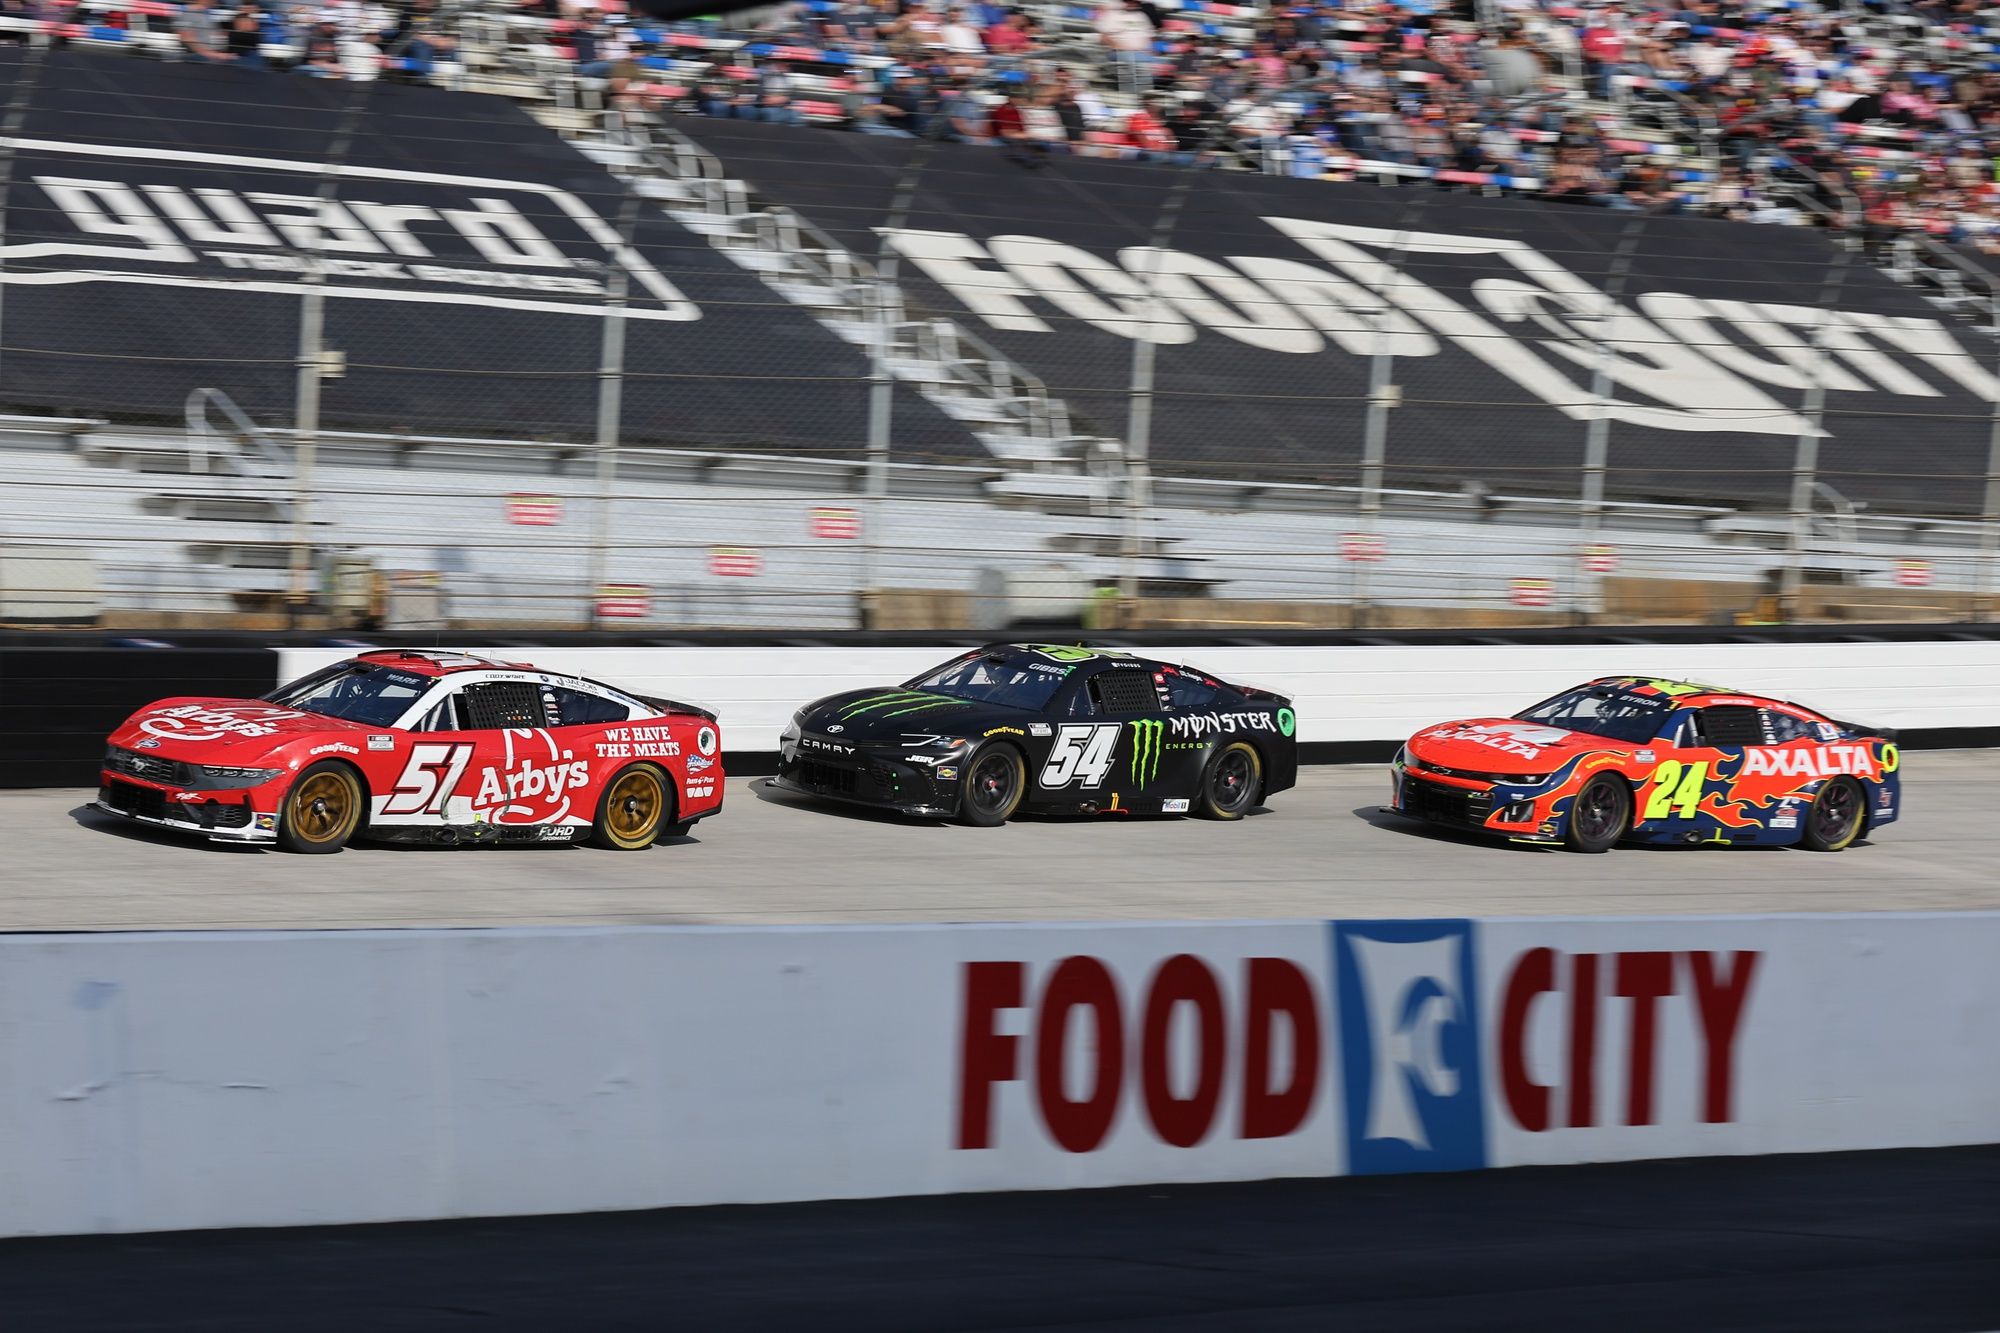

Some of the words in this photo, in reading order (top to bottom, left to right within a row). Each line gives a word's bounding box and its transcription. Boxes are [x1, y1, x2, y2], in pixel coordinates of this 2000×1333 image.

[31, 175, 574, 268] guard
[202, 250, 416, 280] TRUCK
[870, 226, 1442, 357] FOOD
[1636, 291, 2000, 402] CITY
[1028, 662, 1066, 675] GIBBS
[386, 673, 420, 685] WARE
[1619, 695, 1662, 707] BYRON
[982, 726, 1025, 738] GOODYEAR
[1169, 712, 1277, 738] MONSTER
[604, 728, 632, 743] WE
[633, 726, 672, 742] HAVE
[310, 742, 360, 755] GOODYEAR
[595, 743, 633, 759] THE
[635, 741, 681, 758] MEATS
[802, 738, 856, 755] CAMRY
[1165, 742, 1213, 750] ENERGY
[904, 754, 935, 765] JGR
[1038, 722, 1123, 790] 54
[1742, 746, 1874, 776] AXALTA
[381, 741, 477, 815] 51
[474, 750, 590, 804] Arby's
[1643, 760, 1710, 819] 24
[539, 826, 575, 837] FORD
[952, 953, 1324, 1154] FOOD
[1498, 946, 1764, 1133] CITY
